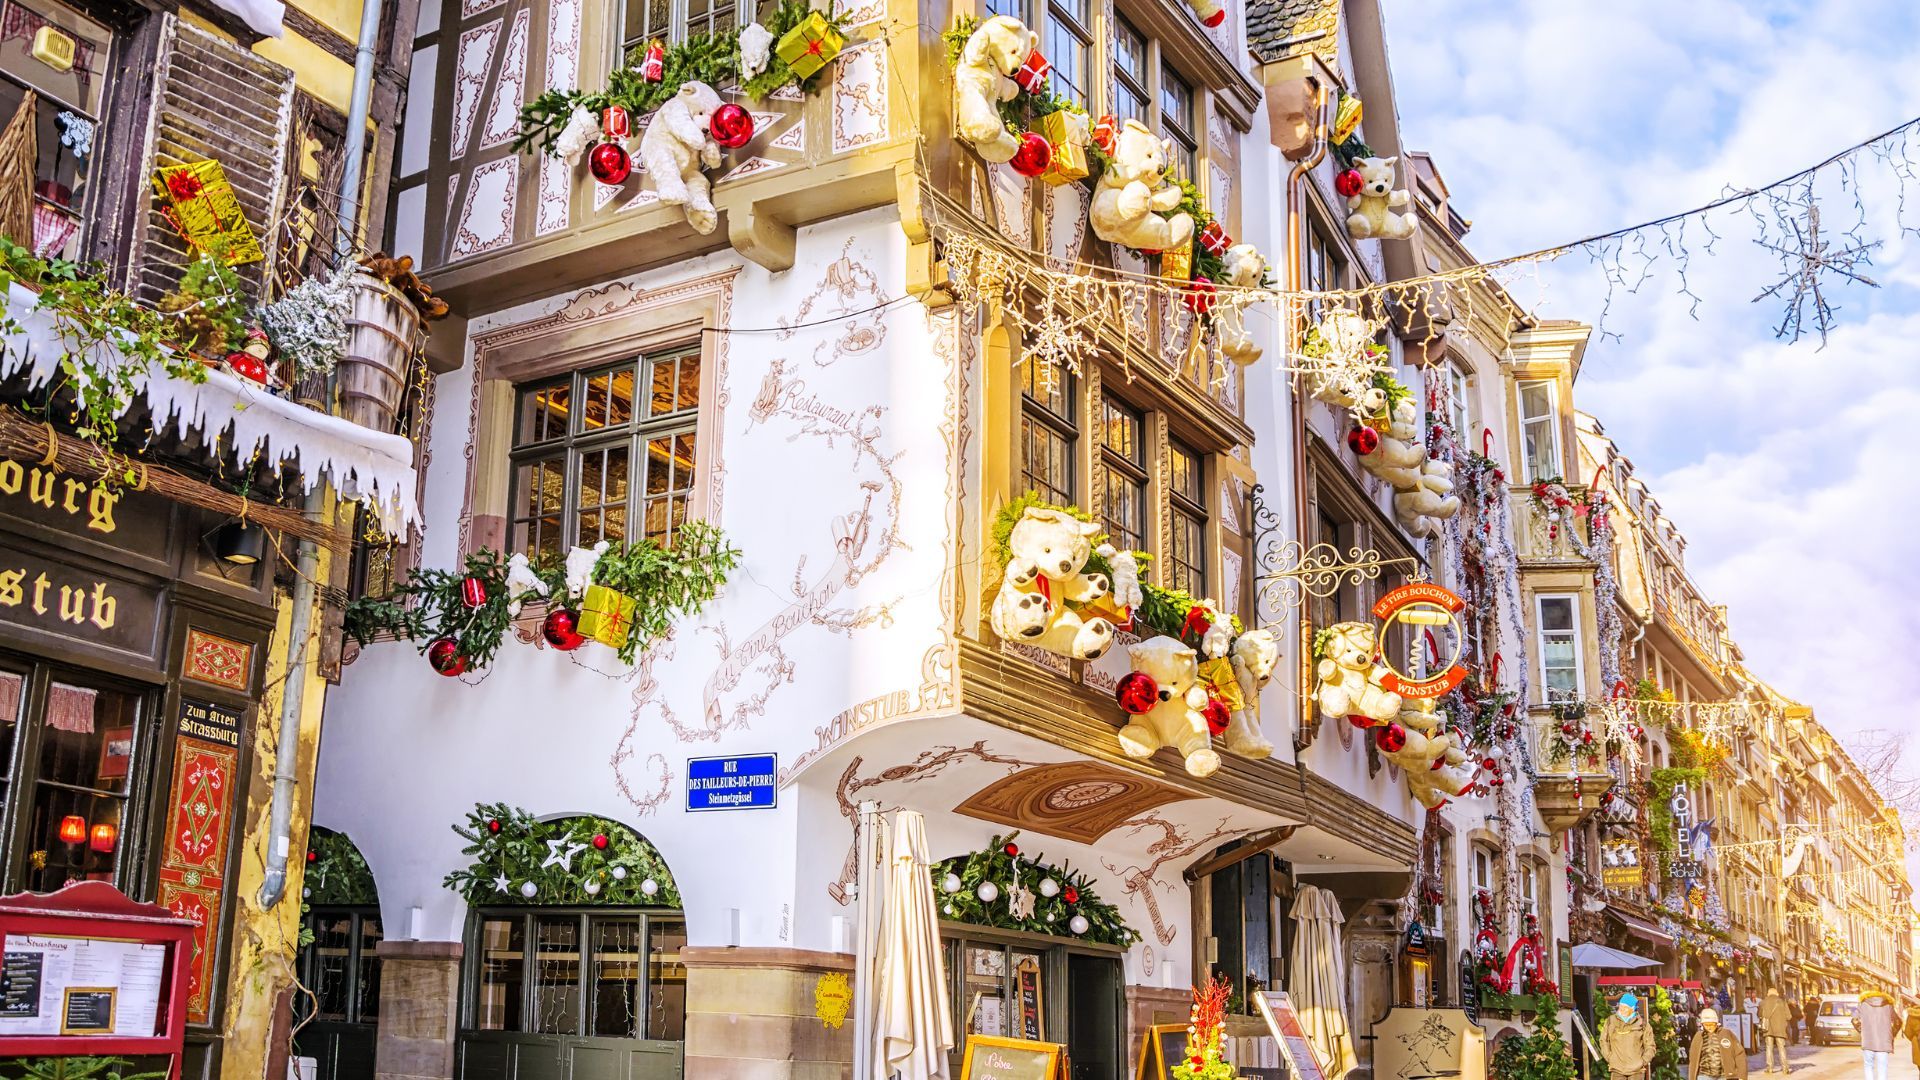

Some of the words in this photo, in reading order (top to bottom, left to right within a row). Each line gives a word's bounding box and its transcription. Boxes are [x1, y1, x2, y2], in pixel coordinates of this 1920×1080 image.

[777, 379, 856, 430] Restaurant
[1377, 602, 1388, 614] LE
[1387, 590, 1409, 605] TIRE
[1409, 587, 1456, 607] BOUCHON
[1397, 679, 1450, 696] WINSTUB
[180, 718, 239, 745] Strassburg
[815, 689, 911, 752] WINSTUB
[723, 761, 738, 773] RUE
[689, 778, 702, 790] DES
[702, 774, 774, 789] TAILLEURS-DE-PIERRE
